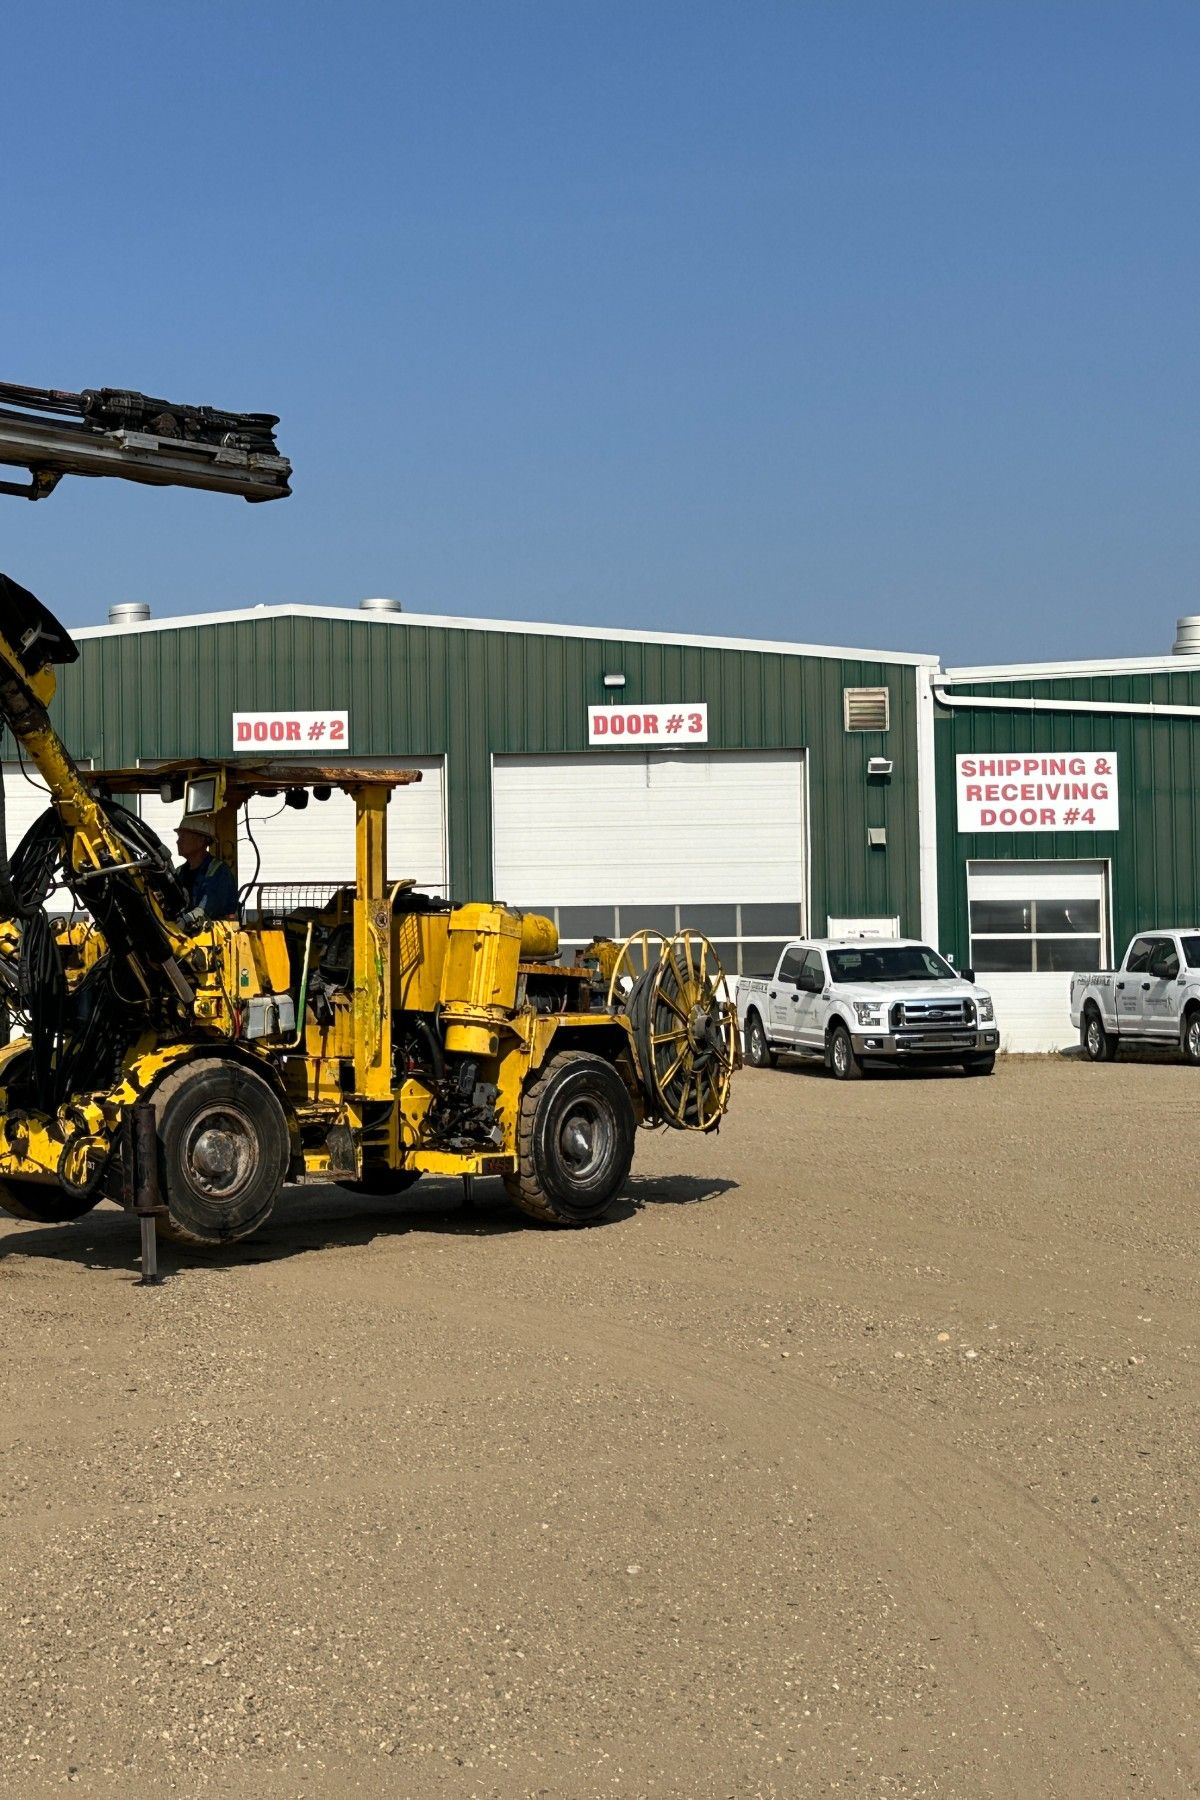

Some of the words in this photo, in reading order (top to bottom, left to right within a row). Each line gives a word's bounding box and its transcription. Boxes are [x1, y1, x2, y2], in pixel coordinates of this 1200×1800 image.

[237, 721, 301, 741] DOOR
[307, 720, 345, 740] #2
[593, 714, 659, 735] DOOR
[665, 713, 703, 734] #3
[961, 758, 1087, 777] SHIPPING
[1094, 757, 1113, 775] &
[966, 782, 1109, 802] RECEIVING
[980, 808, 1056, 826] DOOR
[1063, 807, 1096, 825] #4
